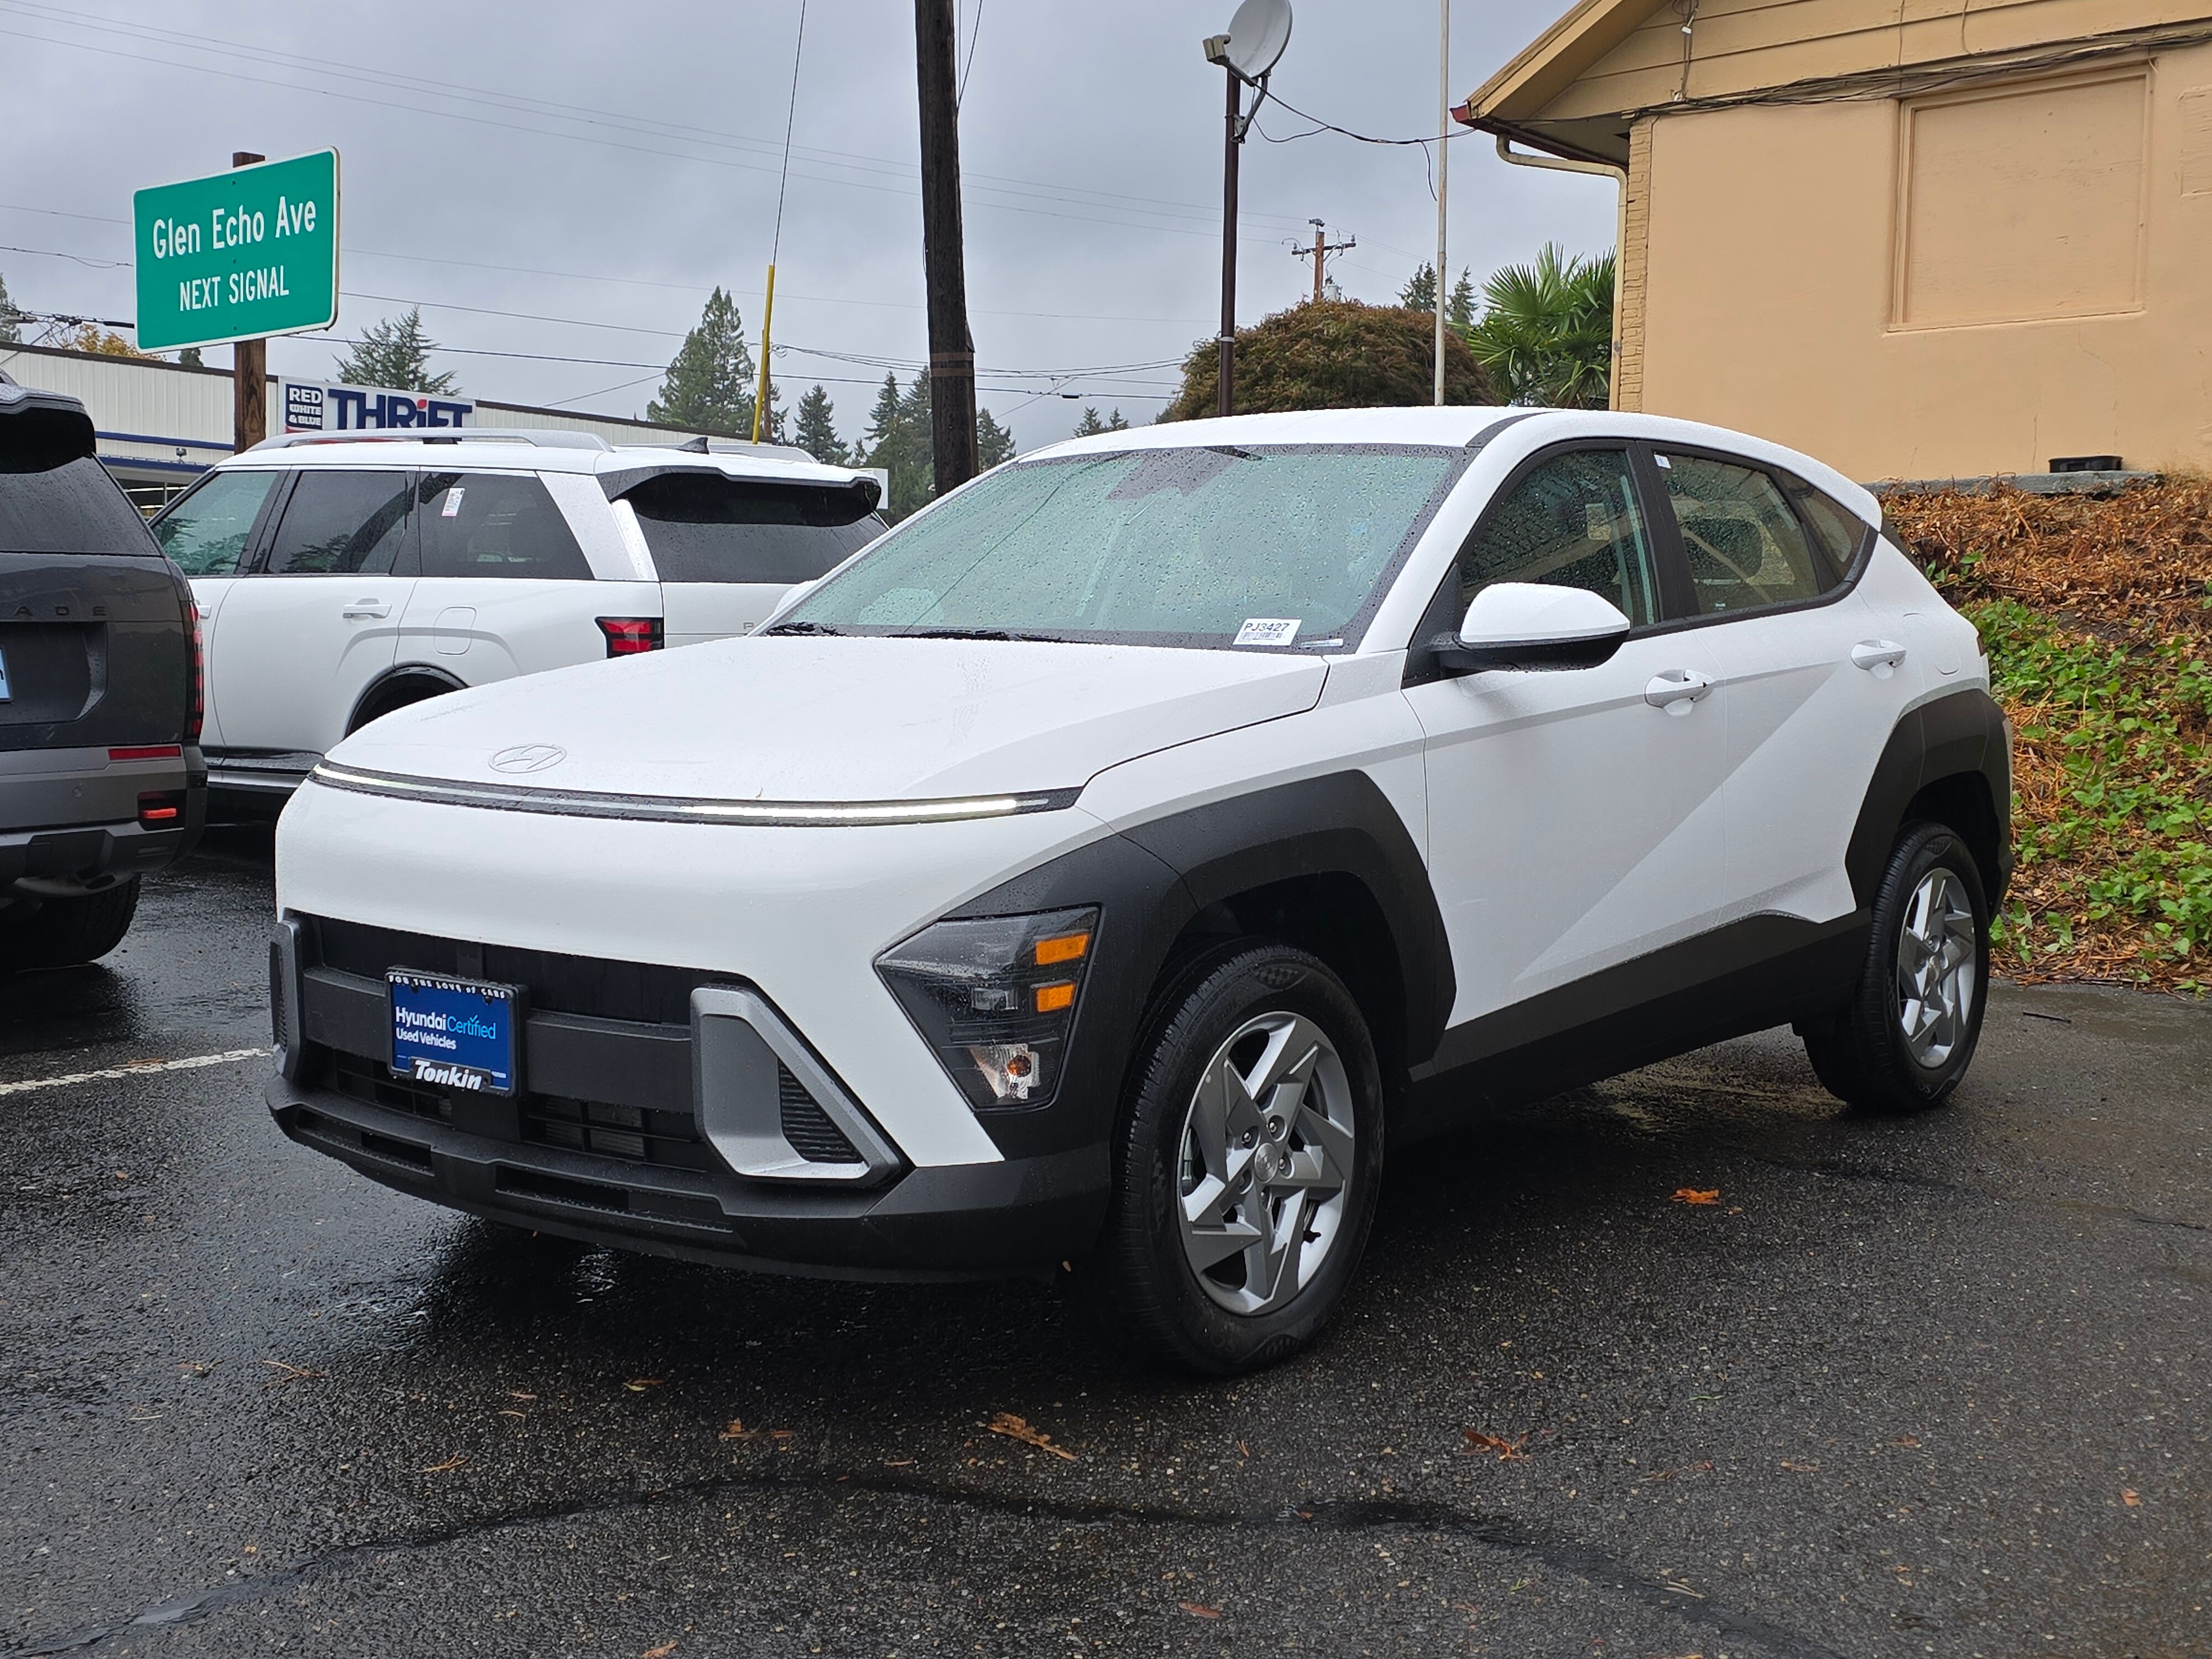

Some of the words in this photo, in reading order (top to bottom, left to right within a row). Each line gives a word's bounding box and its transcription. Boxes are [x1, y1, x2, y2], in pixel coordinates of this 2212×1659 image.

[153, 218, 201, 259] Glen
[212, 205, 264, 249] Echo
[275, 196, 316, 238] Ave
[179, 276, 221, 311] NEXT
[229, 265, 289, 304] SIGNAL
[289, 388, 322, 404] RED
[289, 404, 322, 415] WHITE
[289, 415, 298, 424] &
[298, 415, 321, 426] BLUE
[1243, 623, 1290, 632] PJ3427
[388, 975, 409, 984] FOR
[413, 978, 432, 987] THE
[436, 982, 462, 993] LOVE
[481, 988, 505, 999] CARS
[395, 1006, 446, 1031] Hyundai
[447, 1015, 496, 1040] Certified
[396, 1028, 419, 1042] Used
[419, 1031, 457, 1050] Vehicles
[415, 1060, 482, 1091] Tonkin
